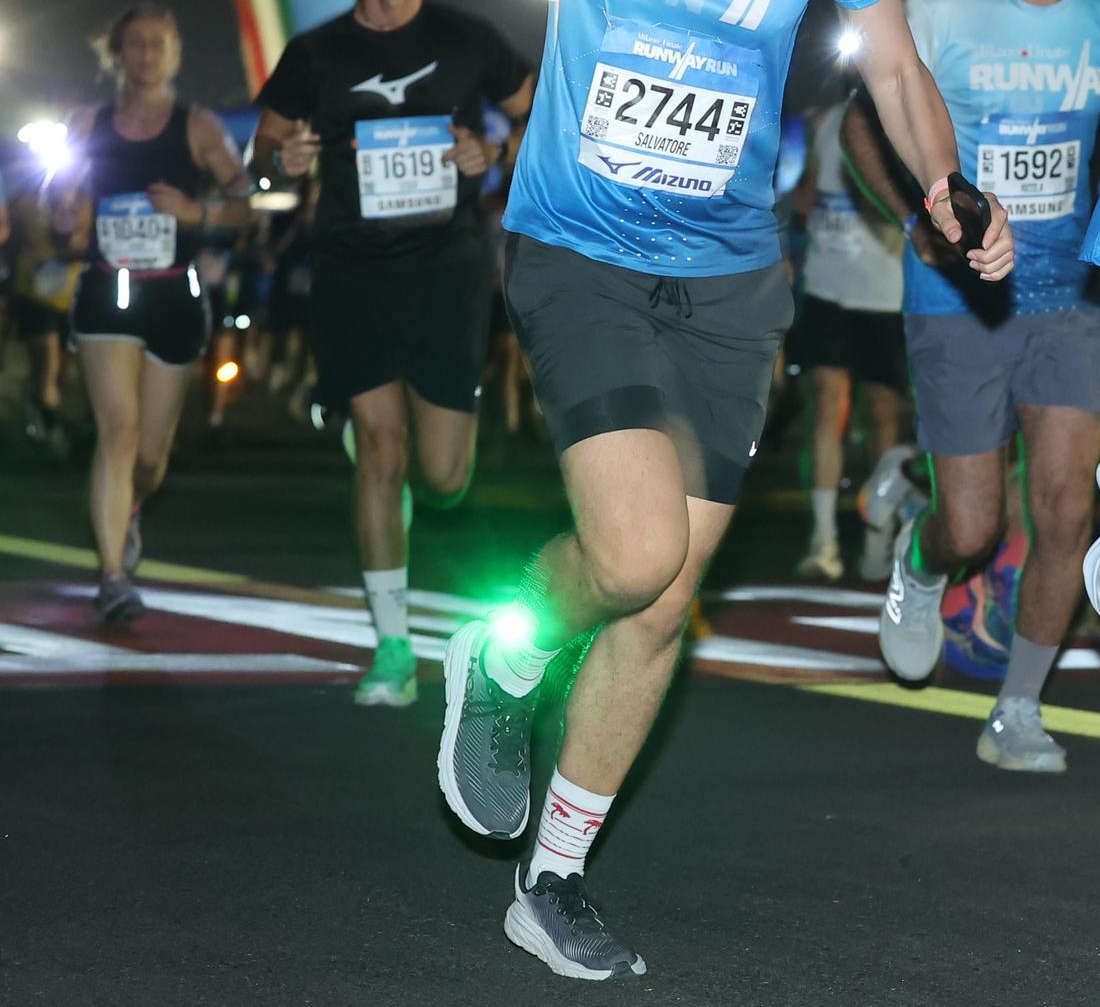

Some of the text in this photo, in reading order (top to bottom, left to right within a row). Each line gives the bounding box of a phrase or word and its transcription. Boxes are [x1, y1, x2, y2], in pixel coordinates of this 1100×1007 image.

[614, 78, 725, 142] 2744
[635, 132, 692, 157] SALVATORE
[380, 150, 435, 179] 1619
[1000, 149, 1063, 181] 1592
